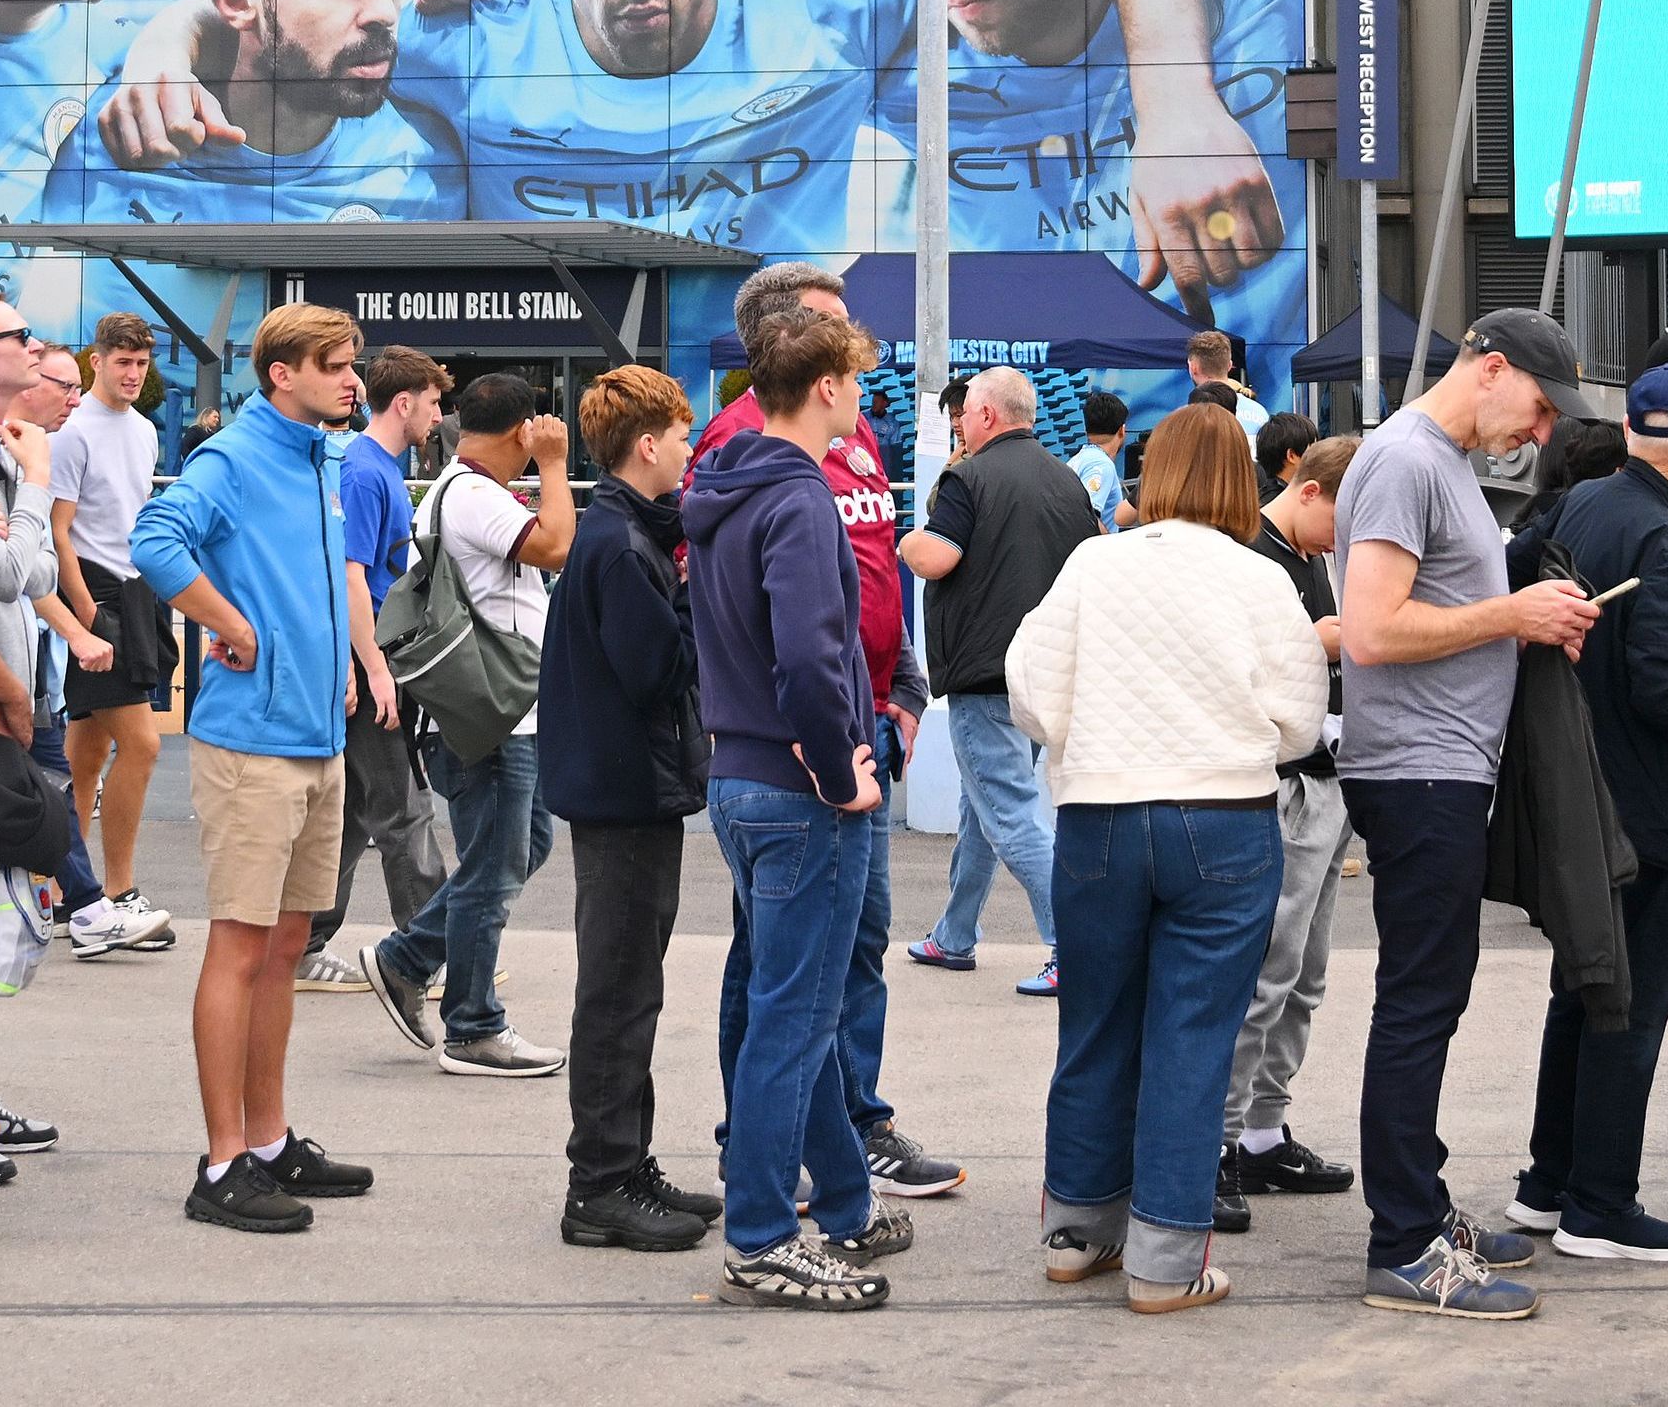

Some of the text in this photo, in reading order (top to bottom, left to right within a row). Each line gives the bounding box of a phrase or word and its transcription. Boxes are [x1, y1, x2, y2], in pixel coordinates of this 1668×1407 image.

[1360, 53, 1376, 163] RECEPTION
[513, 146, 810, 219] ETIHAD
[356, 292, 393, 320] THE
[398, 292, 459, 320] COLIN
[465, 292, 514, 320] BELL
